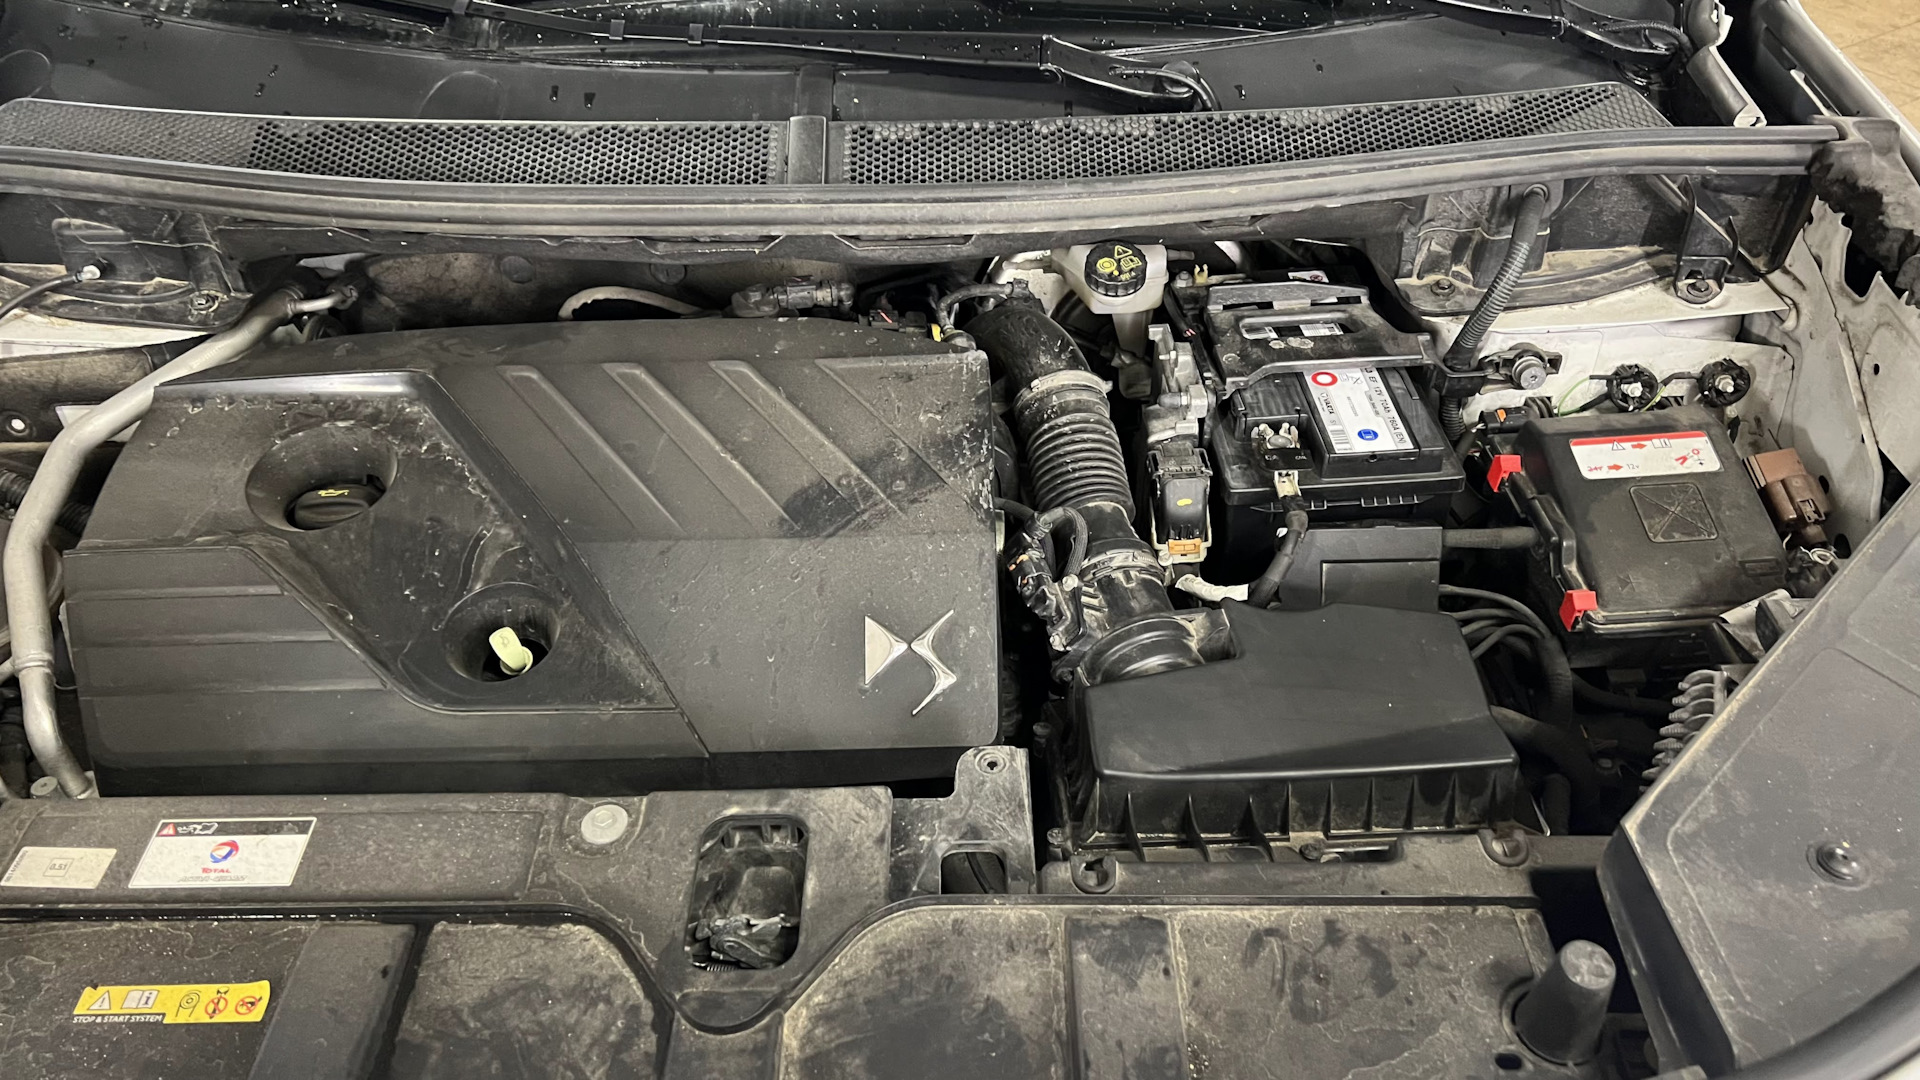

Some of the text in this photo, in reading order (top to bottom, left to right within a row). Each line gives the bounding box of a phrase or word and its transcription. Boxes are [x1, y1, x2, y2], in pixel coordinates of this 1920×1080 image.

[1373, 386, 1384, 397] 12V
[1387, 416, 1400, 431] 760A
[1393, 430, 1407, 444] (EN)
[72, 1015, 96, 1023] STOP
[103, 1015, 131, 1023] START
[130, 1014, 163, 1023] SYSTEM
